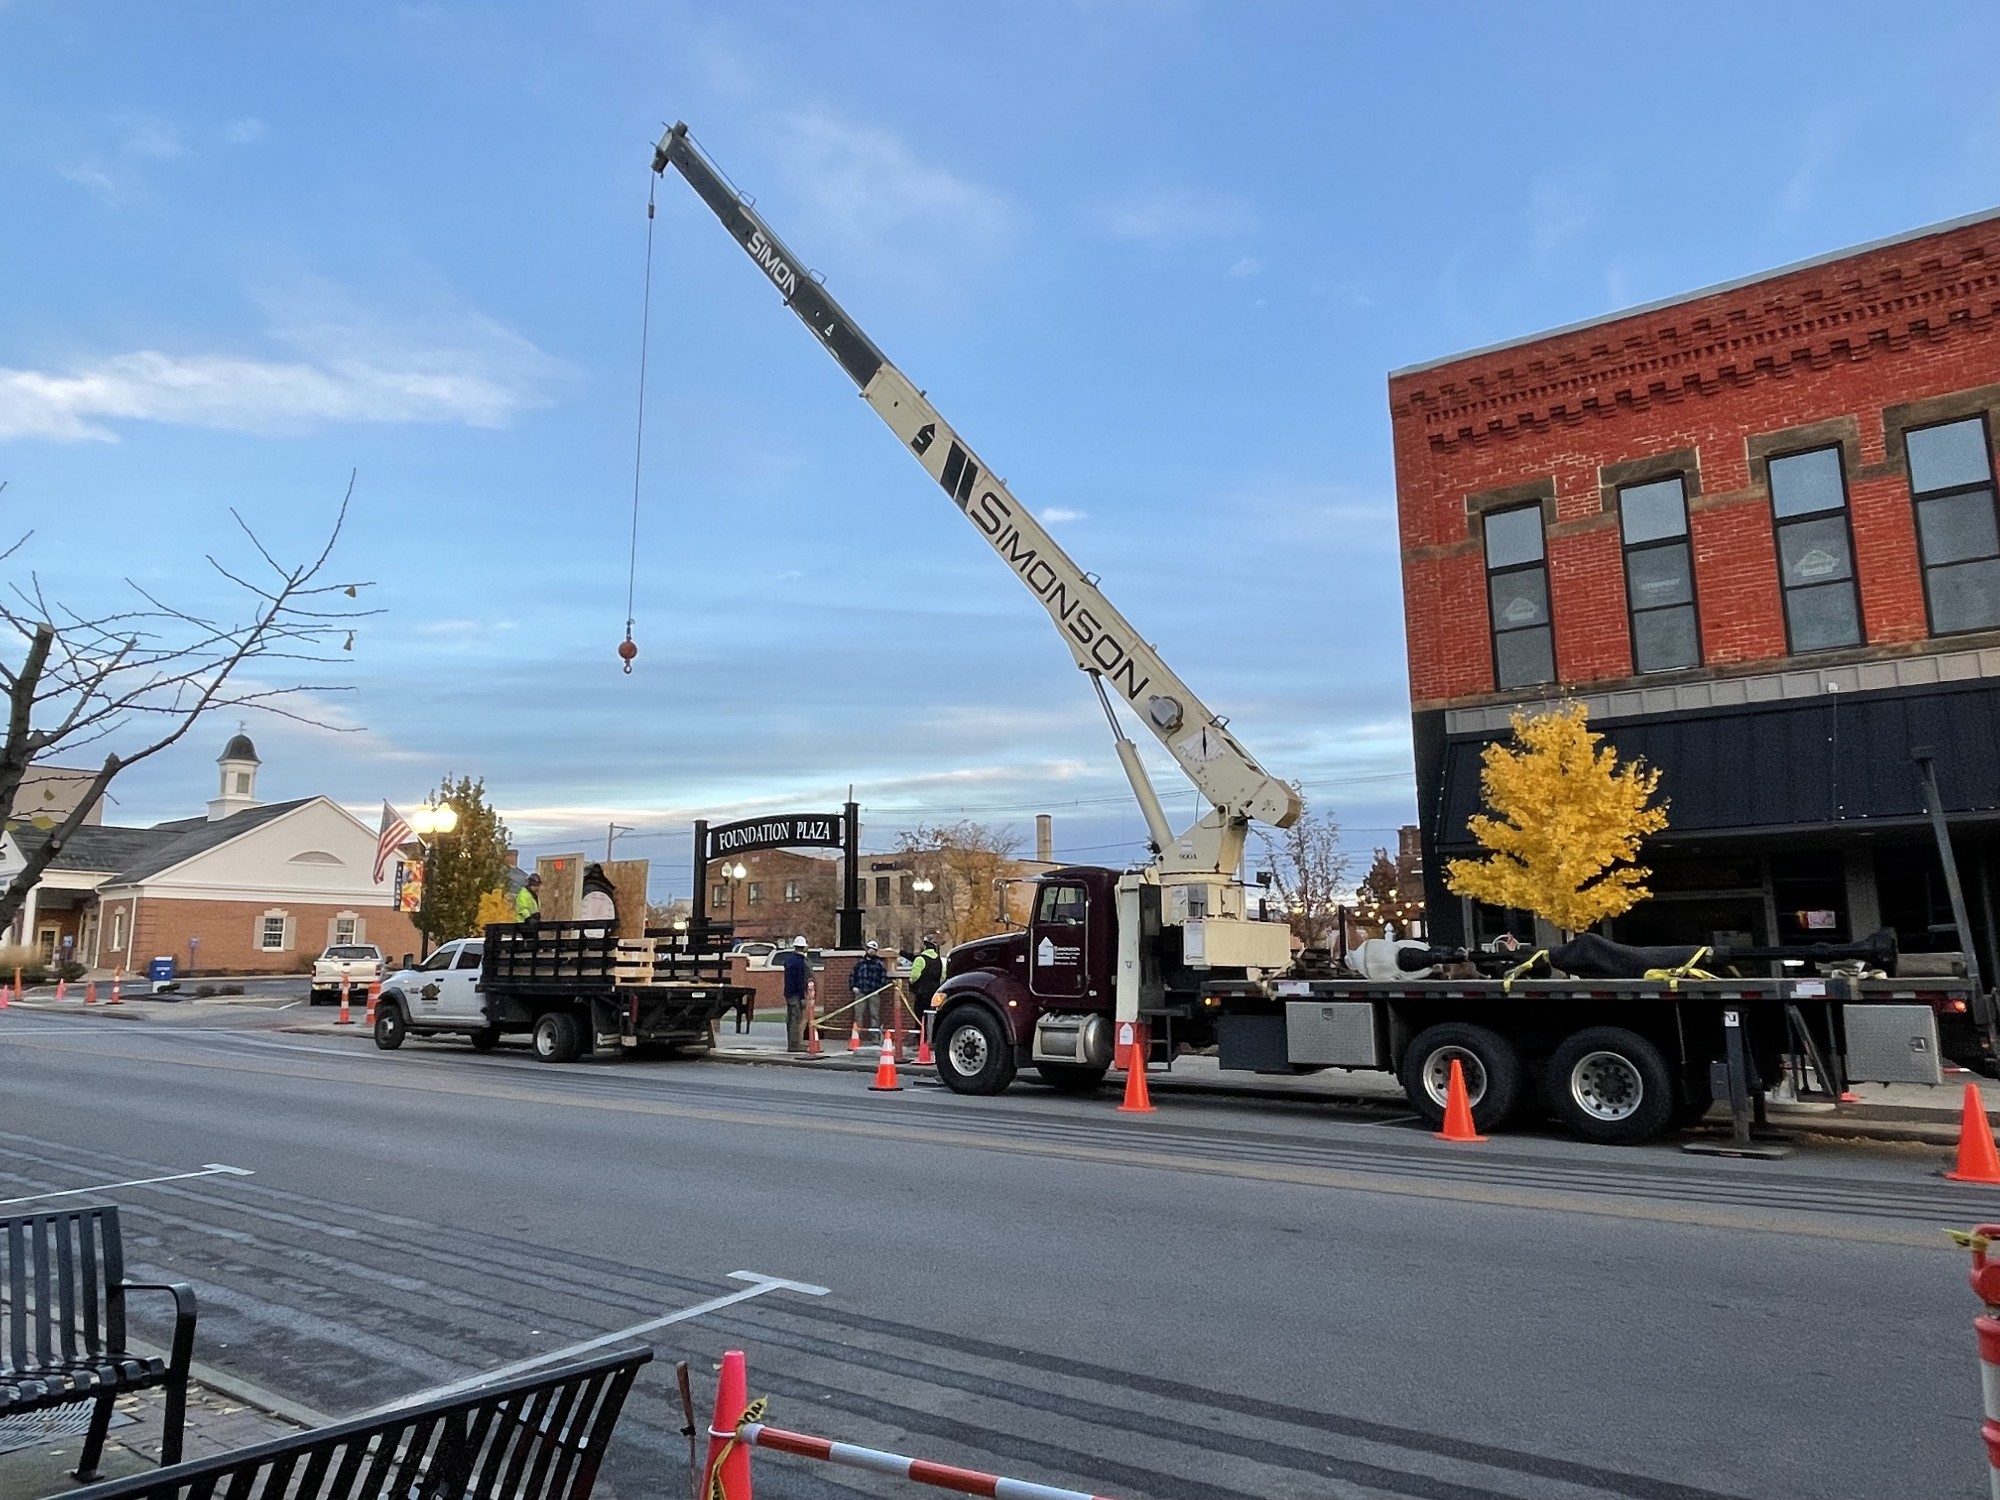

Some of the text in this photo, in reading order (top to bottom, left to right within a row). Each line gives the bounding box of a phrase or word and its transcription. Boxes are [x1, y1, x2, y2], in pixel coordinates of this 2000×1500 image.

[970, 491, 1150, 700] SIMONSON
[719, 821, 831, 850] FOUNDATION PLAZA
